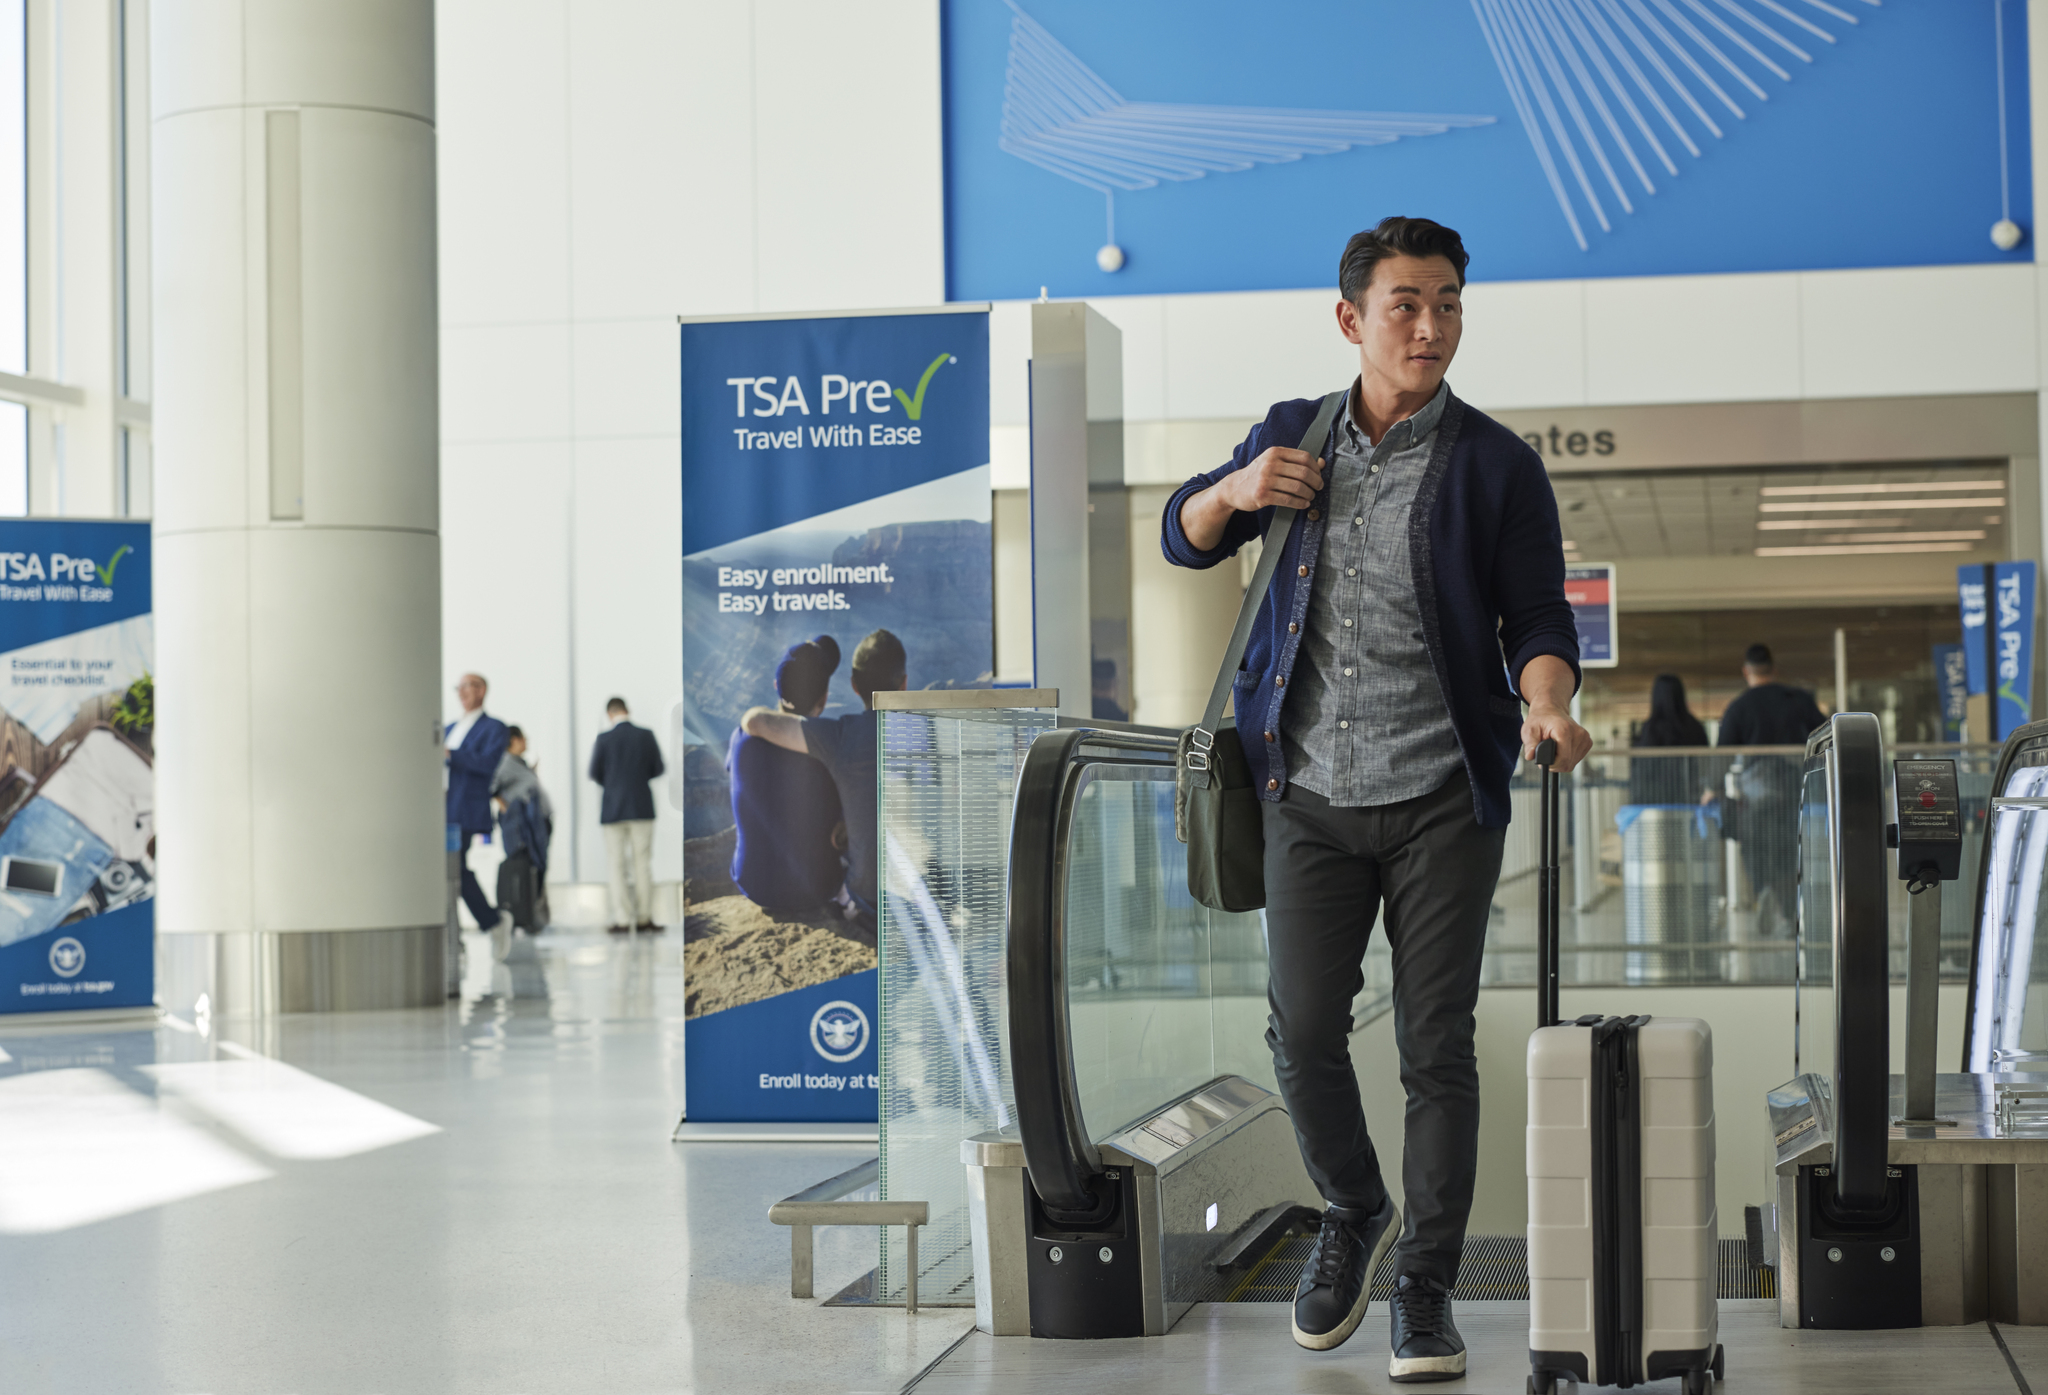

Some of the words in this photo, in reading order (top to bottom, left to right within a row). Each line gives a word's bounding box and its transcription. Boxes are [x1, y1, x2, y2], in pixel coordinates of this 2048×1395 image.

[726, 376, 810, 418] TSA
[821, 374, 892, 415] Pre
[733, 426, 803, 450] Travel
[809, 424, 863, 448] With
[869, 424, 922, 446] Ease
[1504, 424, 1616, 456] ates
[0, 552, 46, 581] TSA
[50, 553, 96, 582] Pre
[718, 566, 768, 590] Easy
[772, 563, 894, 586] enrollment.
[0, 584, 42, 601] Travel
[43, 584, 78, 601] With
[79, 584, 114, 602] Ease
[718, 592, 768, 616] Easy
[772, 589, 851, 612] travels.
[1998, 571, 2021, 629] TSA
[11, 658, 66, 670] Essential
[69, 658, 82, 670] to
[86, 660, 113, 674] your
[1999, 631, 2022, 680] Pre
[11, 674, 47, 686] travel
[759, 1073, 801, 1089] Enroll
[804, 1073, 847, 1091] today
[849, 1074, 865, 1089] at
